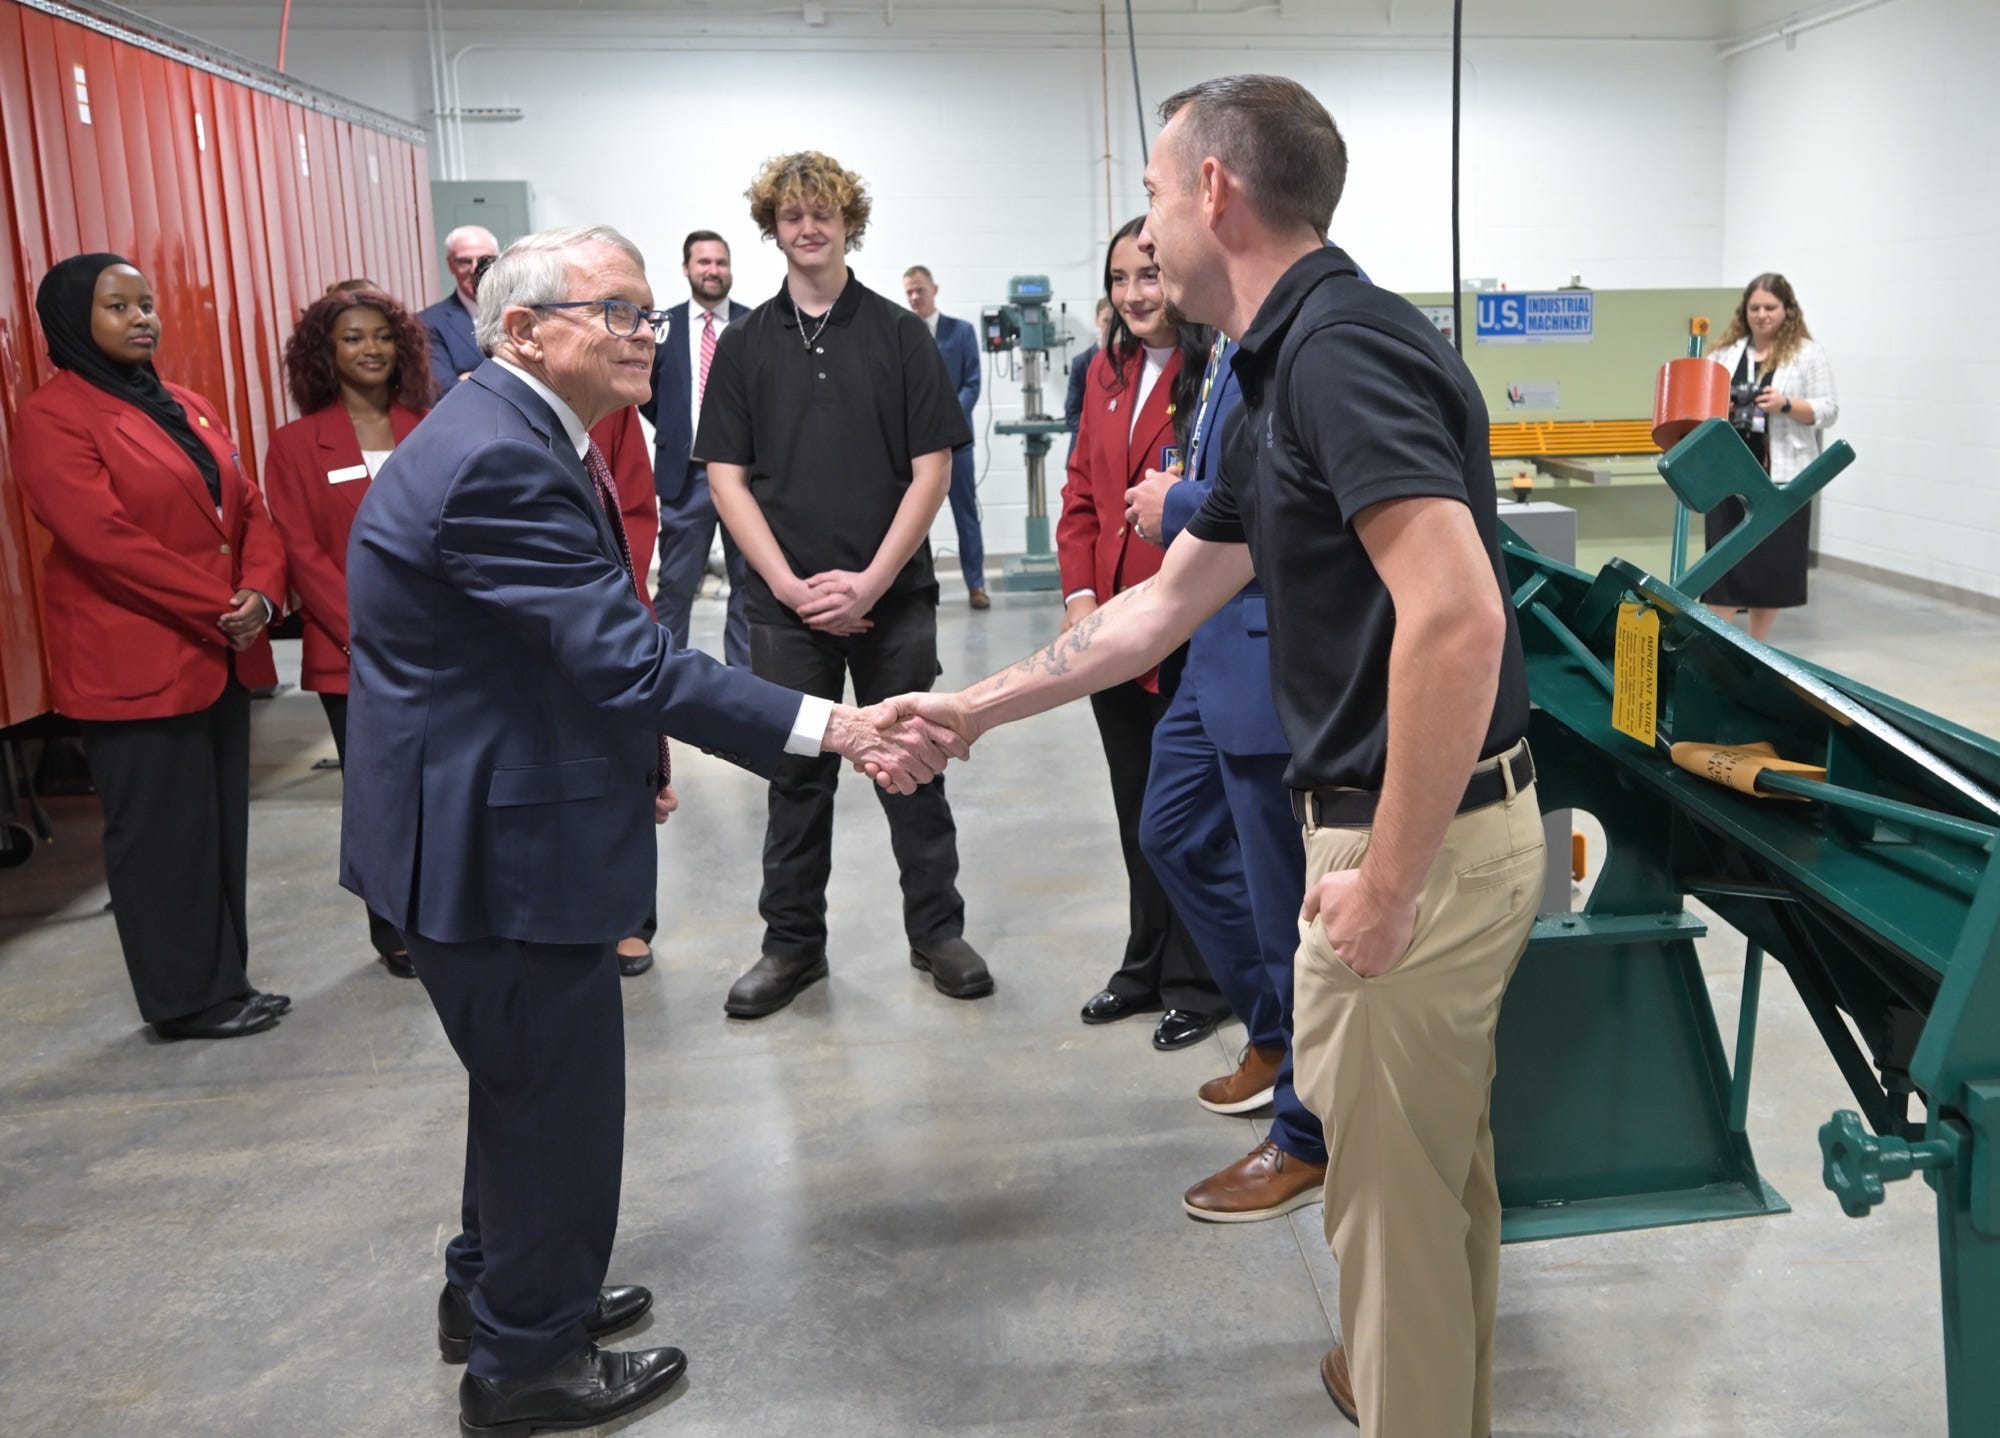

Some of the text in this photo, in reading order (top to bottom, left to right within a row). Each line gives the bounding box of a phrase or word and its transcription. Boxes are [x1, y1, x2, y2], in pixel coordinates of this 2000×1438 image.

[1479, 299, 1523, 330] U.S.
[1528, 297, 1590, 313] INDUSTRIAL
[1528, 315, 1590, 331] MACHINERY
[1644, 635, 1654, 736] IMPORTANT NOTICE
